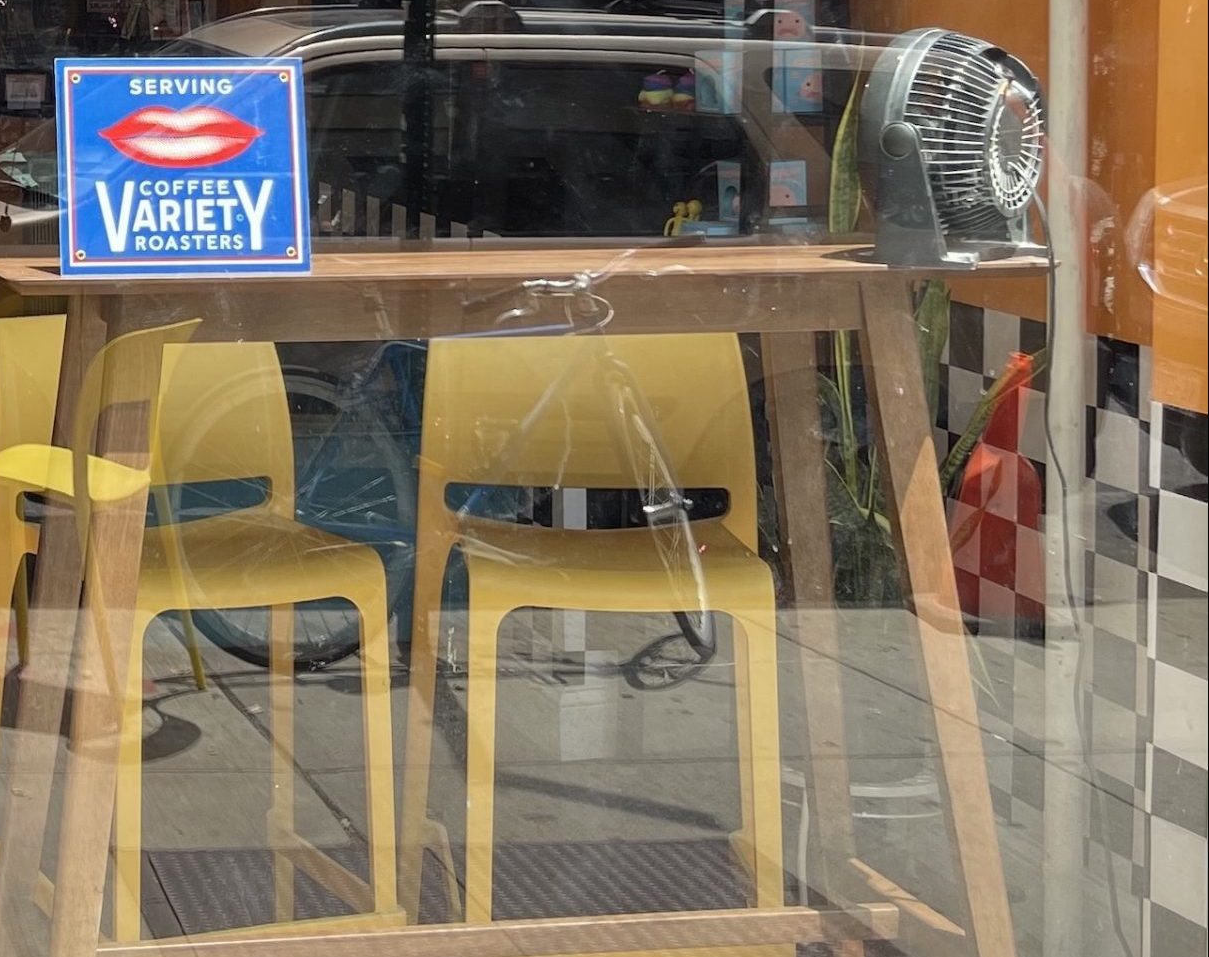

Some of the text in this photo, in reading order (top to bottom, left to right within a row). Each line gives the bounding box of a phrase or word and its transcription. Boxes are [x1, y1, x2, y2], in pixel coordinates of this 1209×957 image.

[129, 78, 233, 95] SERVING
[139, 180, 230, 196] COFFEE
[95, 179, 274, 253] VARIETY
[135, 234, 244, 251] ROASTERS
